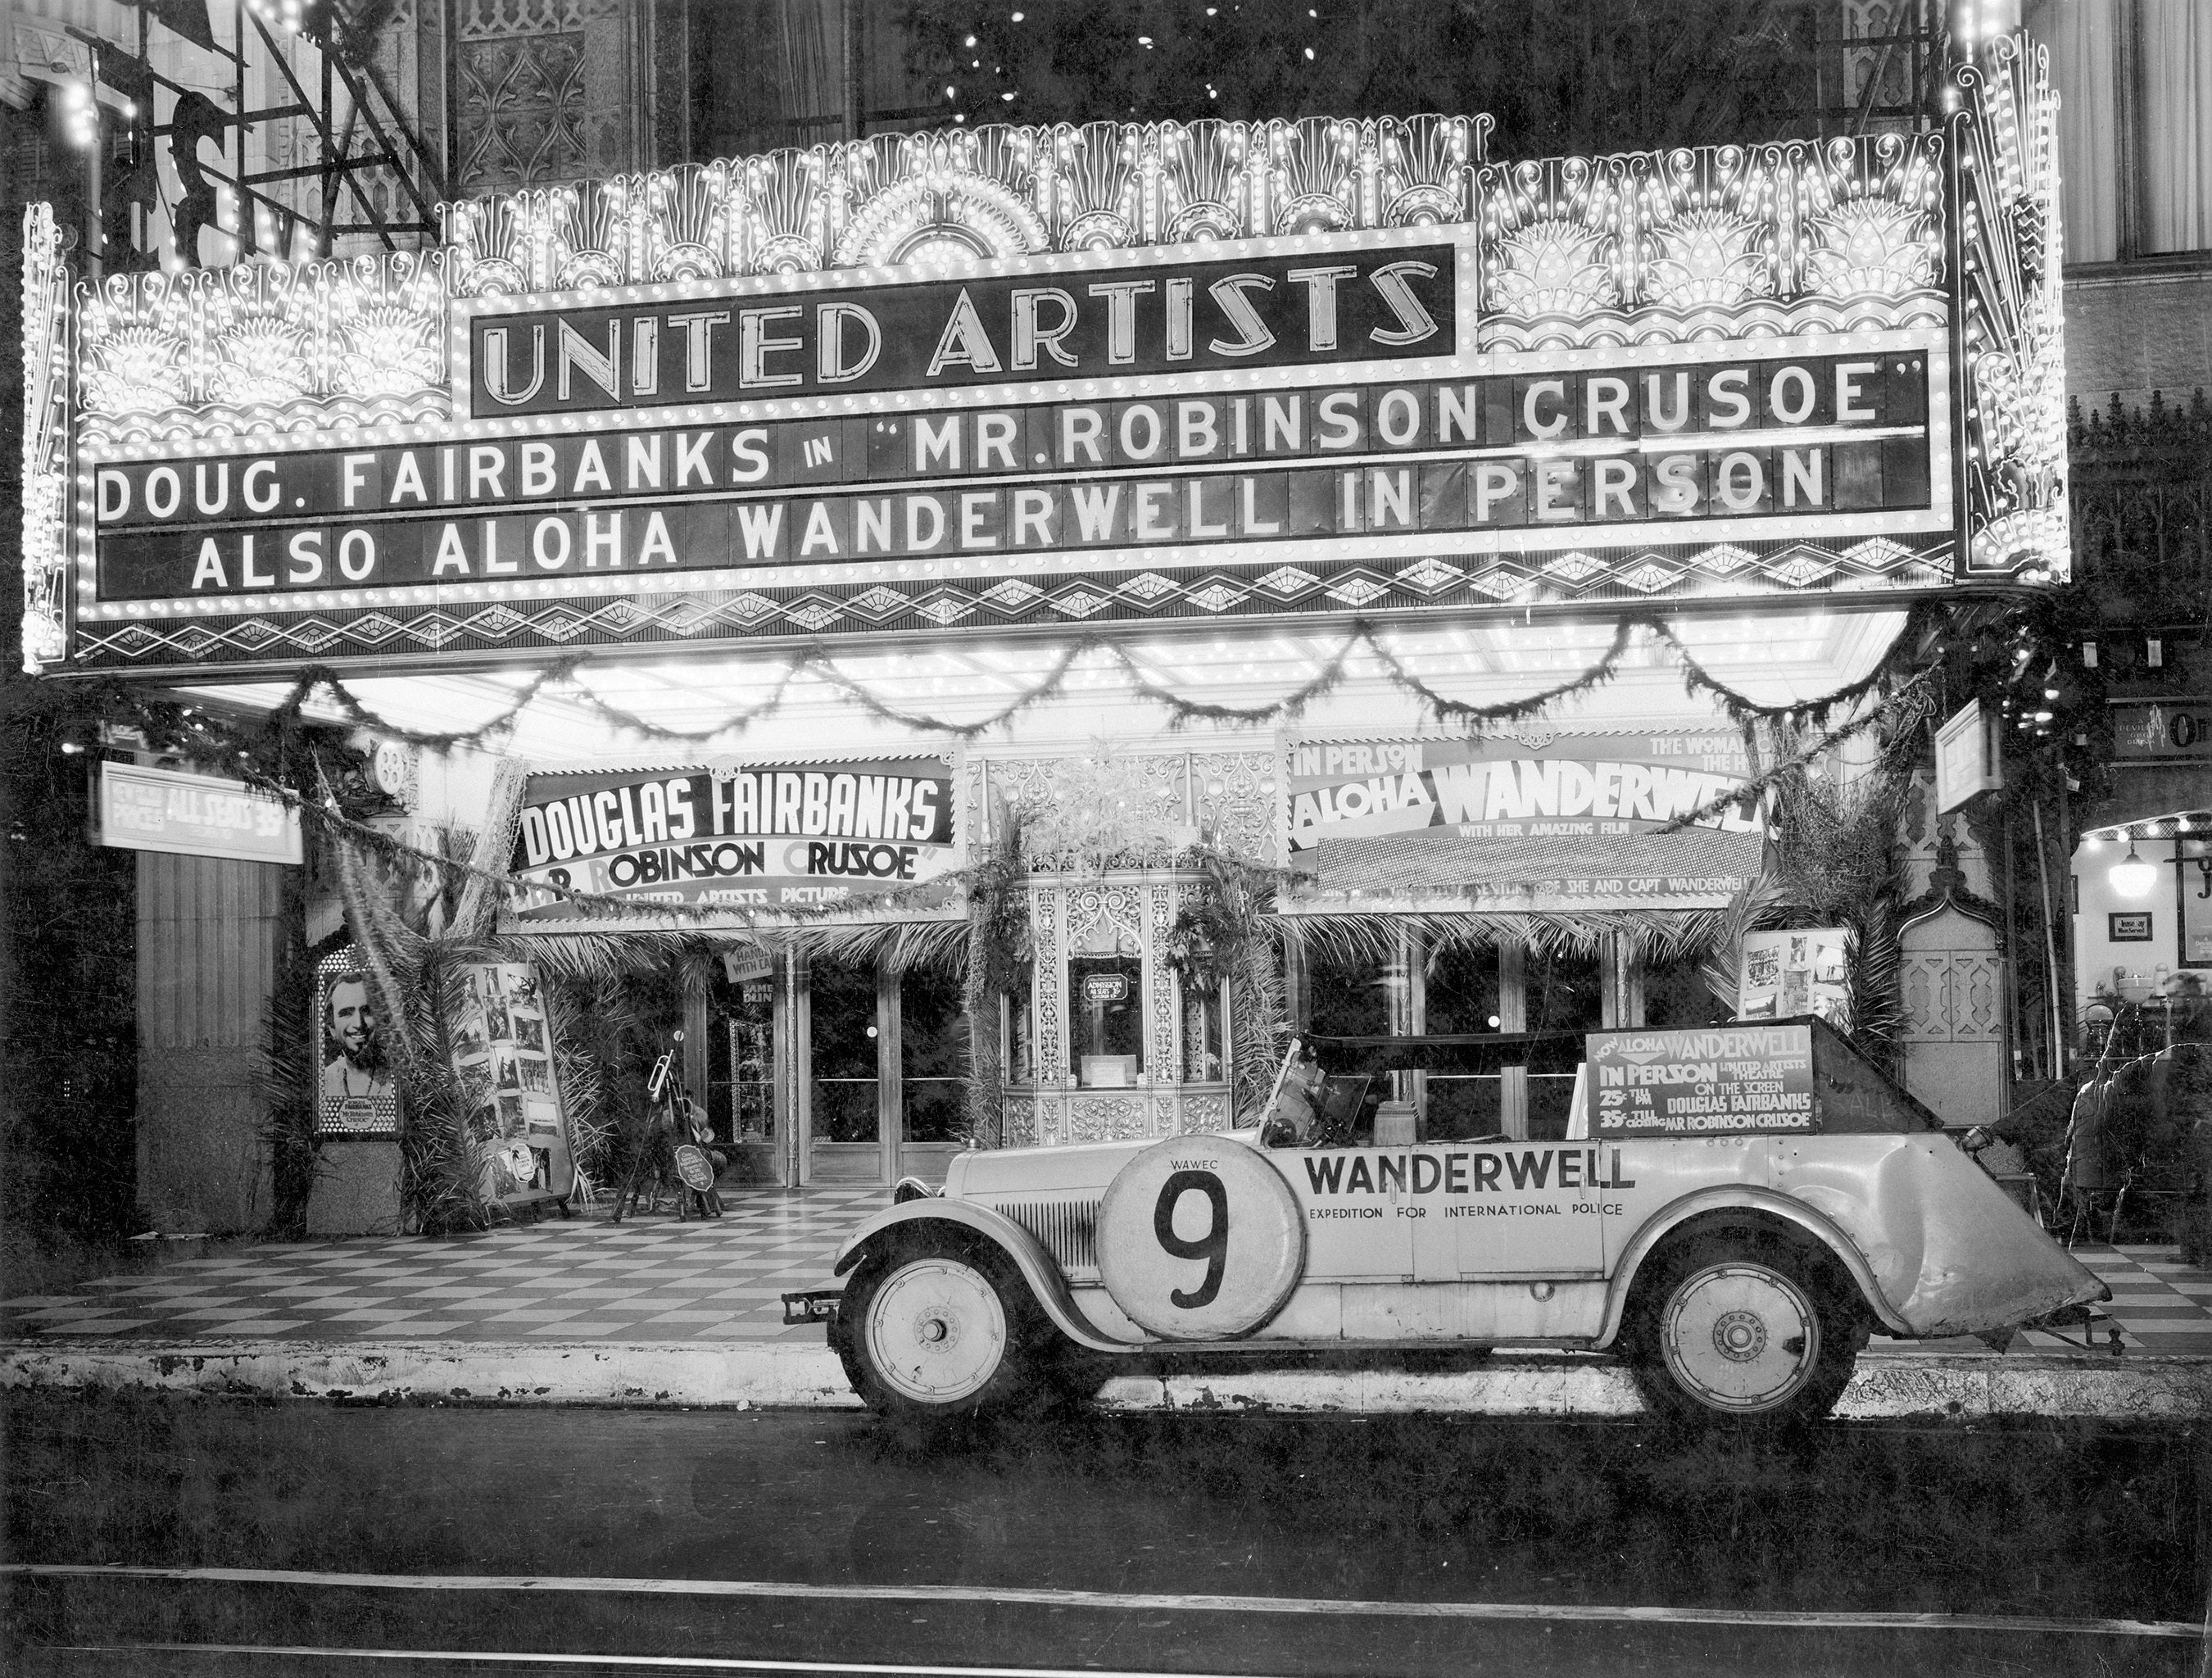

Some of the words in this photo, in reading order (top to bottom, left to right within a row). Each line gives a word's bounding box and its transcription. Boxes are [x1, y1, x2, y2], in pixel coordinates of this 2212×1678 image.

[483, 302, 883, 404] UNITED
[926, 261, 1439, 377] ARTISTS
[97, 460, 306, 521] DOUG.
[343, 429, 769, 506] FAIRBANKS
[803, 436, 833, 468] IN
[1063, 386, 1475, 463] ROBINSON
[192, 528, 375, 589] ALSO
[432, 510, 677, 576] ALOHA
[738, 478, 1279, 559] WANDERWELL
[1344, 470, 1410, 529] IN
[1476, 449, 1824, 522] PERSON
[1650, 737, 1682, 755] THE
[1294, 746, 1321, 776] IN
[1326, 744, 1423, 775] PERSON
[1702, 755, 1730, 772] THE
[1292, 772, 1434, 828] ALOHA
[523, 779, 695, 867] DOUGLAS
[712, 773, 939, 841] FAIRBANKS
[1458, 824, 1492, 837] WITH
[1497, 823, 1524, 837] HER
[1530, 823, 1594, 836] AMAZING
[1601, 822, 1630, 835] FILM
[588, 841, 765, 893] ROBINSON
[1566, 879, 1589, 893] SHE
[1594, 879, 1624, 893] AND
[1628, 878, 1661, 892] CAPT
[698, 888, 768, 904] ARTISTS
[733, 961, 757, 975] WITH
[1593, 1036, 1619, 1062] NOW
[1616, 1037, 1666, 1053] ALOHA
[1664, 1031, 1806, 1060] WANDERWELL
[1599, 1065, 1624, 1087] IN
[1627, 1062, 1718, 1086] PERSON
[1720, 1060, 1761, 1073] UNITED
[1762, 1059, 1807, 1073] ARTISTS
[1732, 1070, 1784, 1081] THEATRE
[1694, 1082, 1715, 1095] ON
[1718, 1082, 1741, 1095] THE
[1743, 1081, 1784, 1094] SCREEN
[1667, 1095, 1728, 1114] DOUGLAS
[1731, 1092, 1812, 1112] FAIRBANKS
[1665, 1116, 1686, 1132] MR
[1687, 1113, 1756, 1131] ROBINSON
[1170, 1160, 1218, 1171] WAWEC
[1303, 1149, 1636, 1195] WANDERWELL
[1310, 1207, 1384, 1220] EXPEDITION
[1397, 1207, 1426, 1219] FOR
[1444, 1204, 1562, 1218] INTERNATIONAL
[1572, 1203, 1624, 1217] POLICE
[1154, 1170, 1229, 1309] 9
